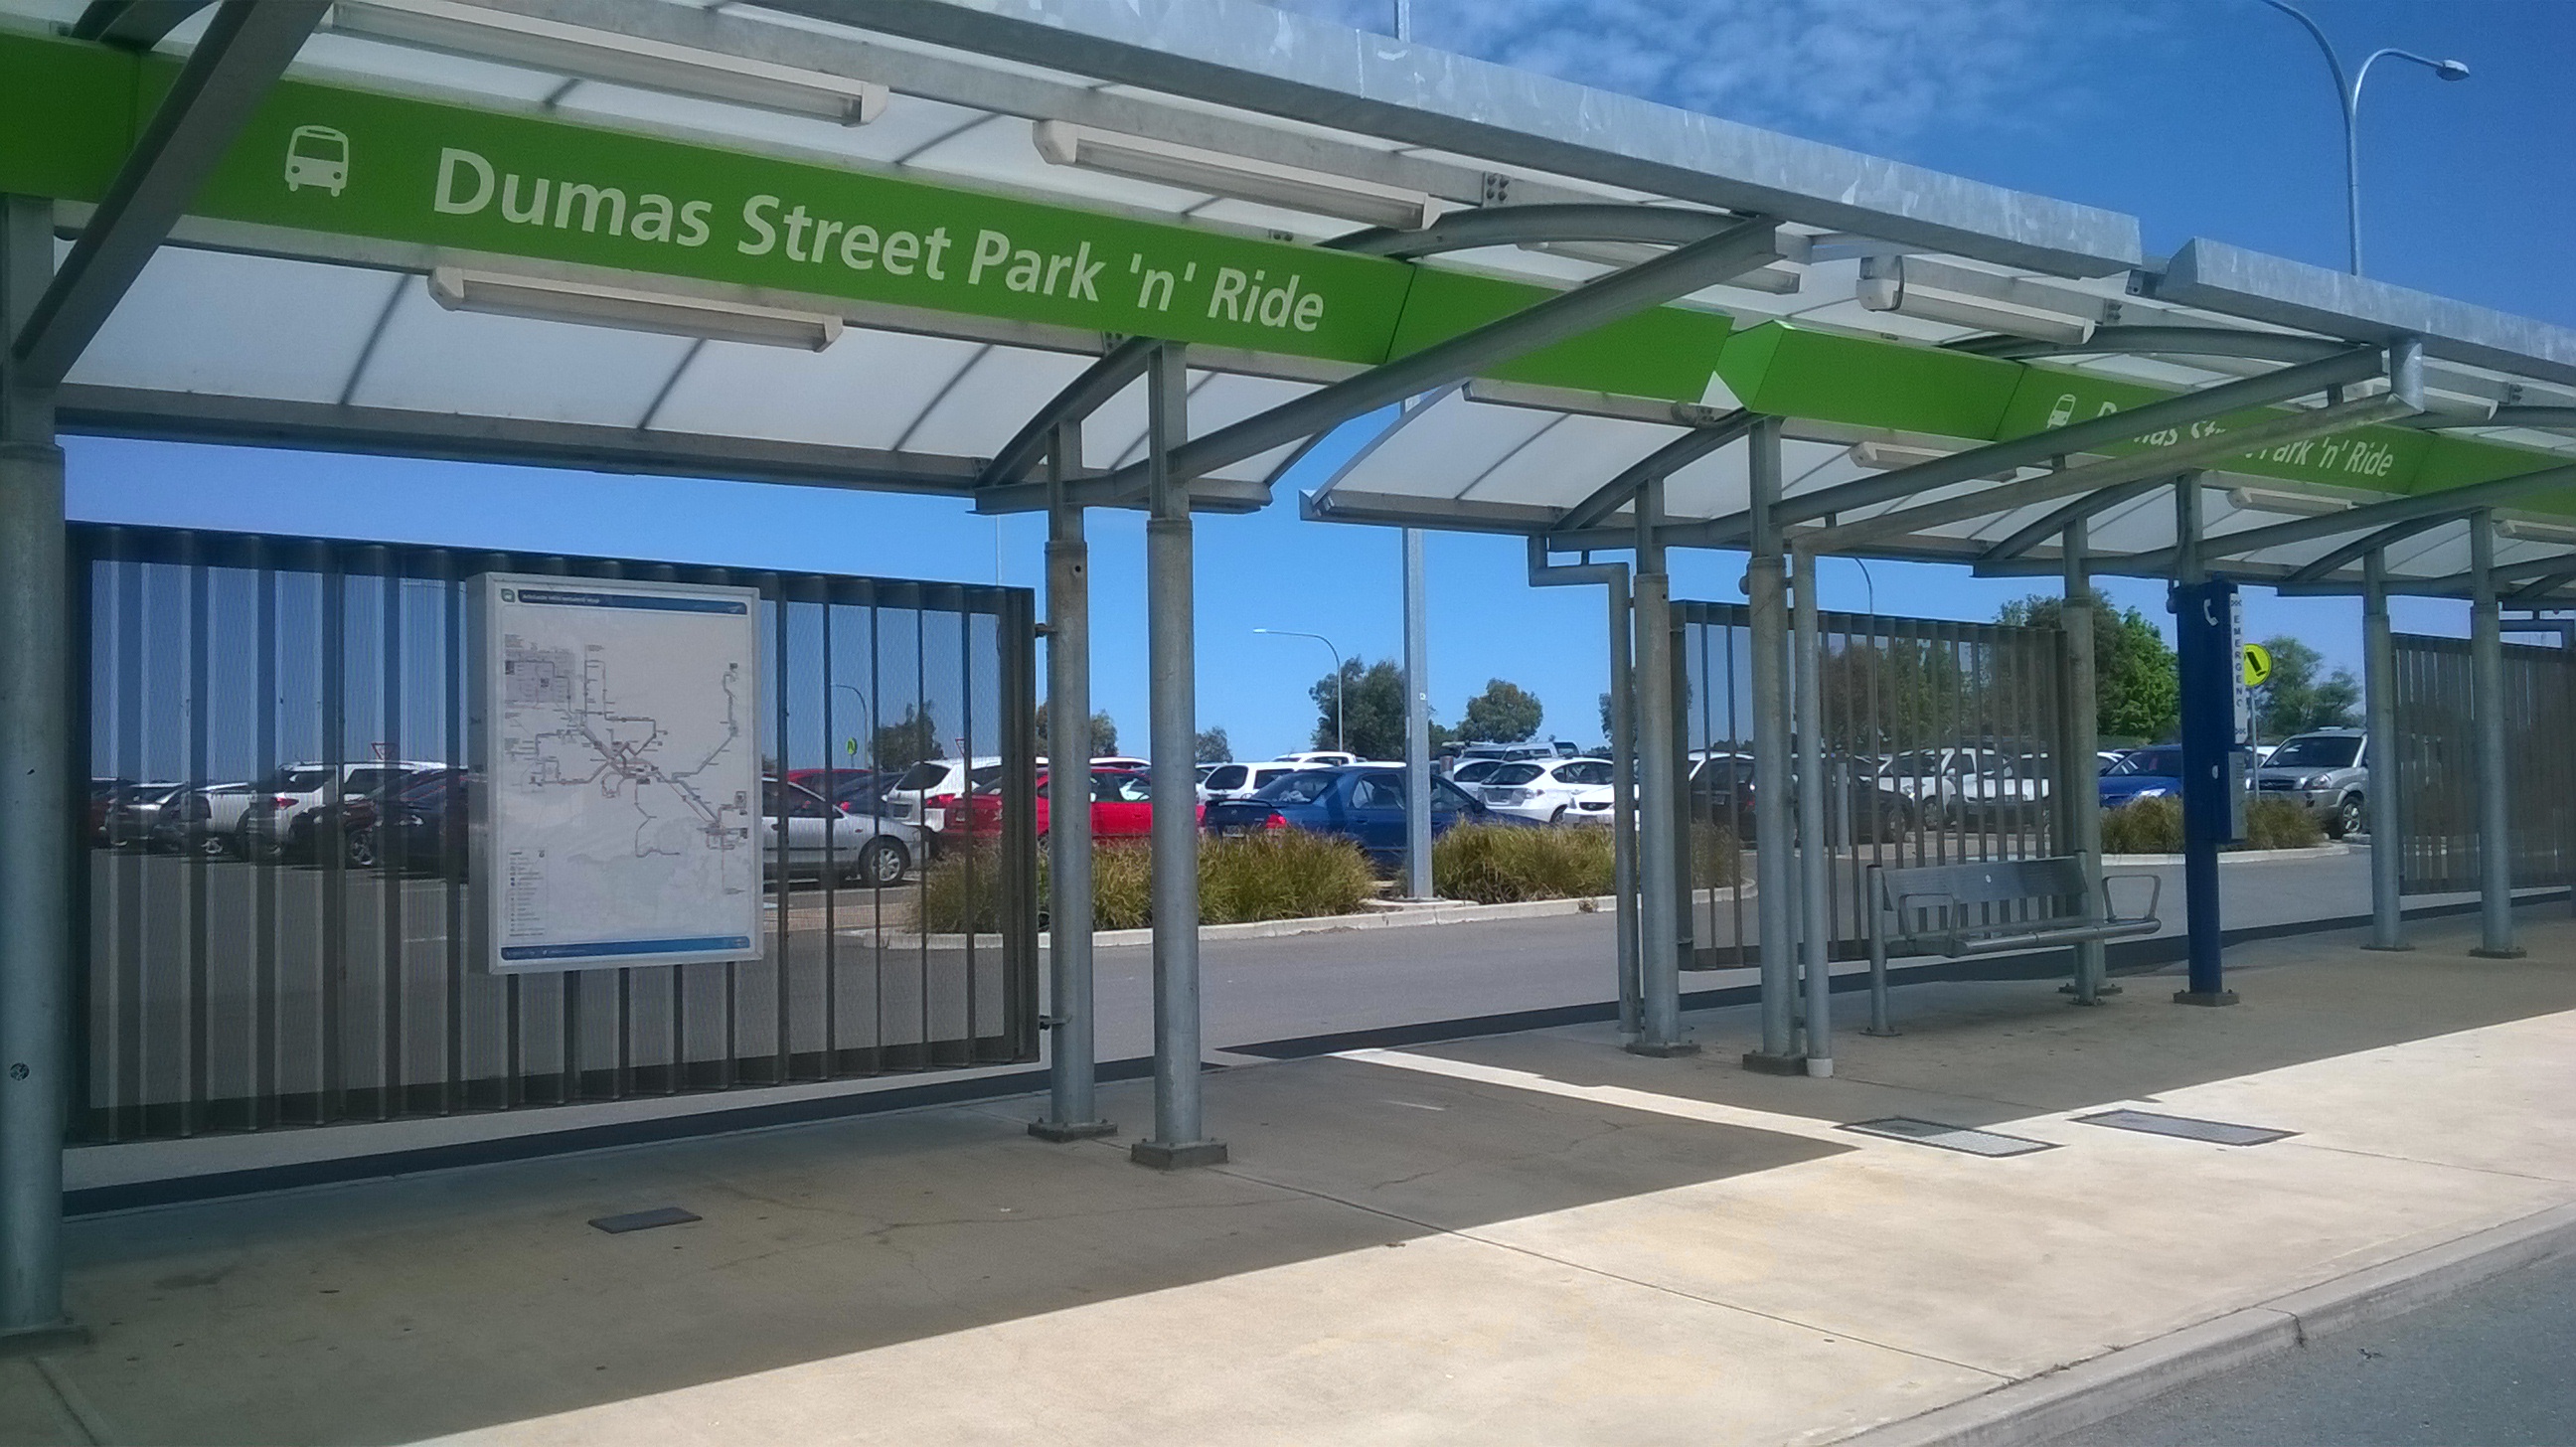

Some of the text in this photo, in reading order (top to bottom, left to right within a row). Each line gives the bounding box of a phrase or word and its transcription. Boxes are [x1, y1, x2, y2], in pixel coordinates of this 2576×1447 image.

[433, 147, 1325, 332] Dumas Street Park 'n' Ride
[2318, 435, 2350, 469] 'n'
[2343, 440, 2394, 477] Ride
